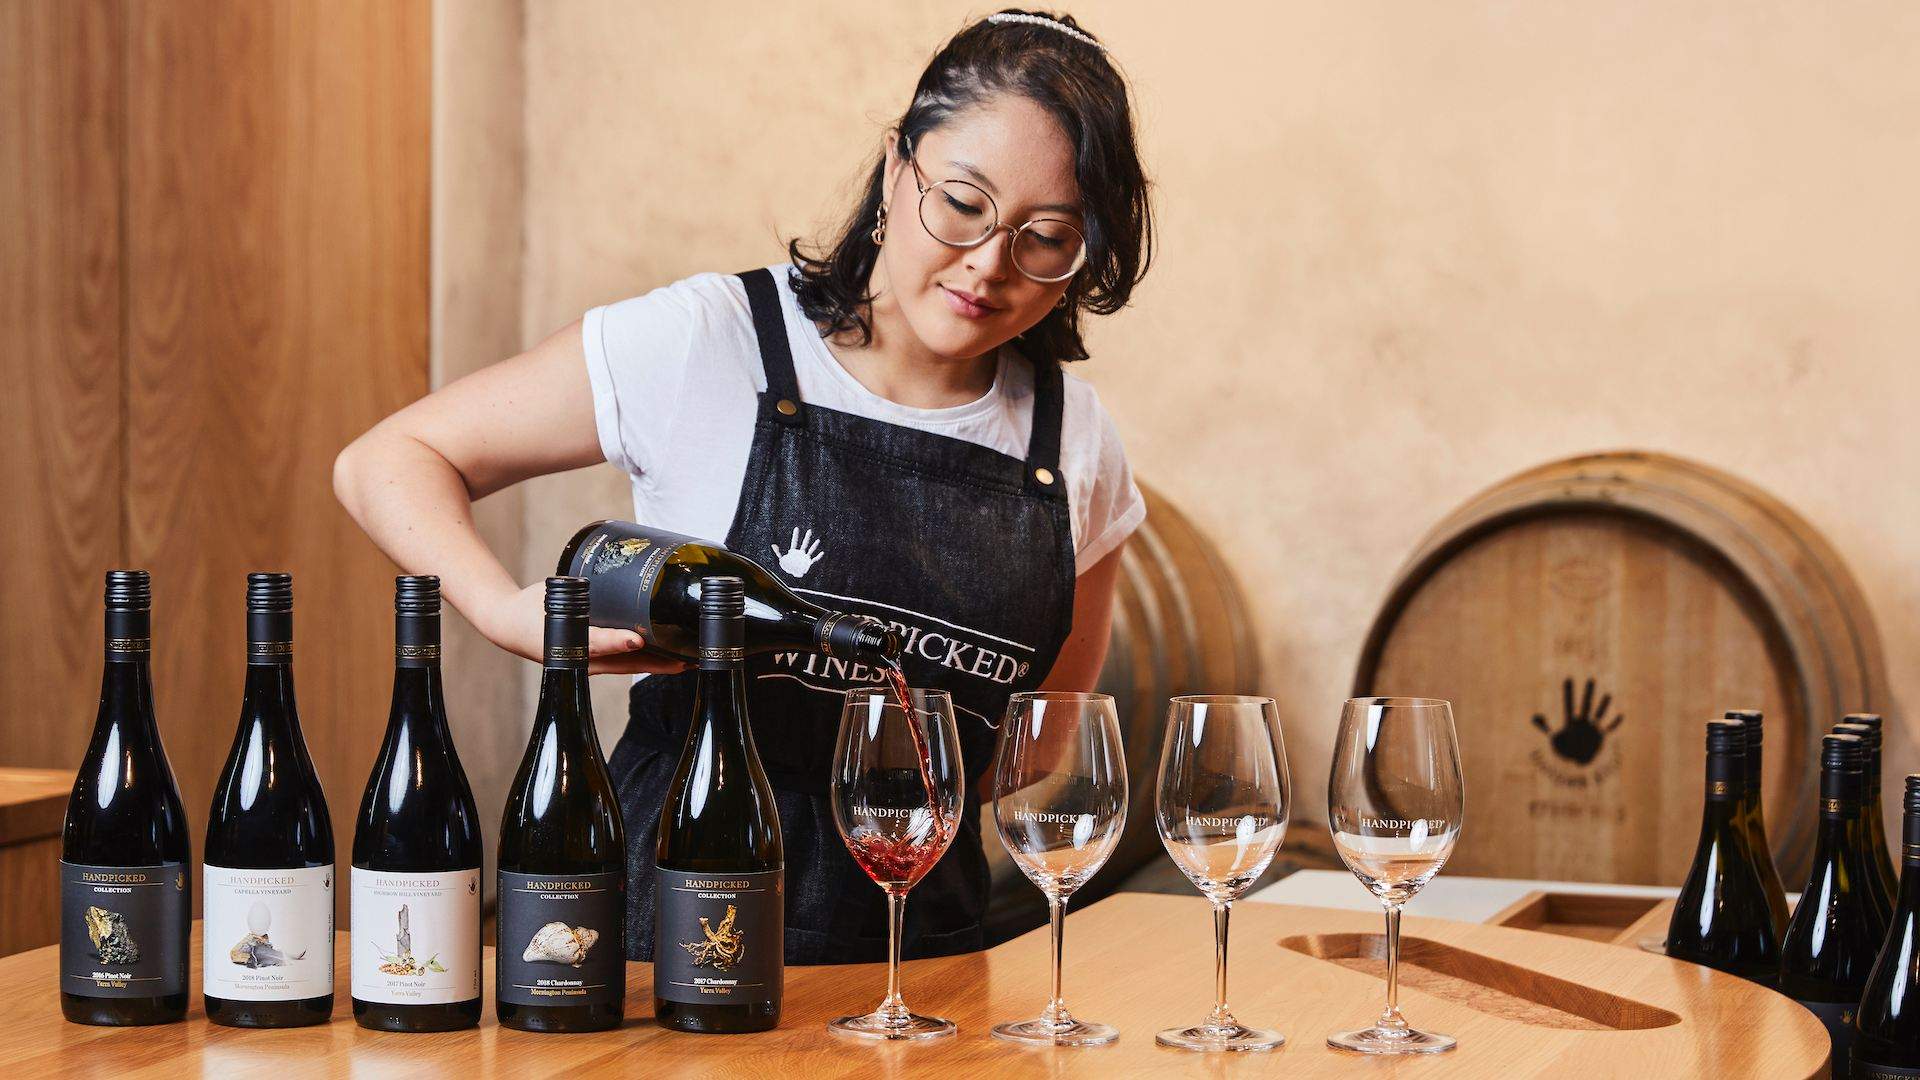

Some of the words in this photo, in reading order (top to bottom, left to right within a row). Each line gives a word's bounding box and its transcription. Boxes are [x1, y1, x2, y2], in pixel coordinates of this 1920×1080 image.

[82, 872, 147, 883] HANDPICKED
[230, 876, 295, 885] HANDPICKED
[376, 879, 441, 888] HANDPICKED
[526, 881, 592, 890] HANDPICKED
[685, 879, 750, 889] HANDPICKED
[93, 886, 132, 894] COLLECTION
[550, 979, 583, 987] Chardonnay
[706, 977, 738, 986] Chardonnay
